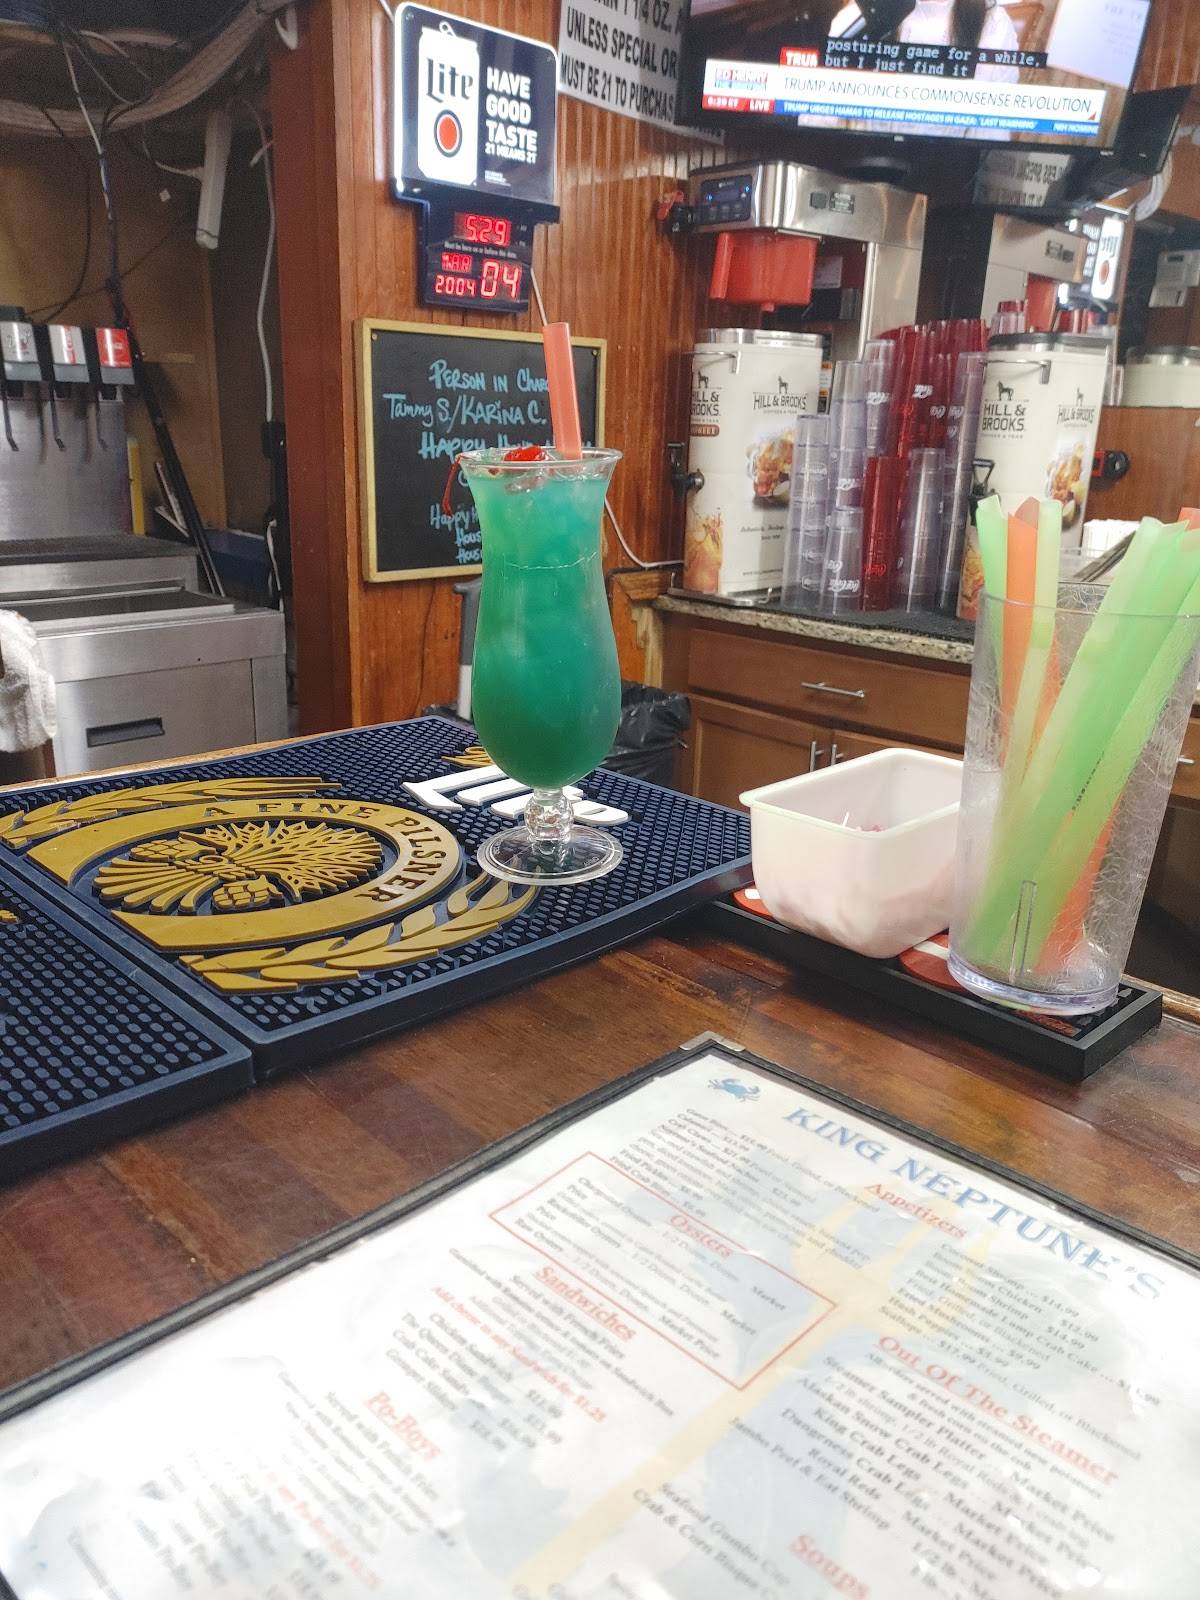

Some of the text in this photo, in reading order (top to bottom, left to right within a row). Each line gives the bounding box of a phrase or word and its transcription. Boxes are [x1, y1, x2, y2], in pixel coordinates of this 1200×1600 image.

[566, 6, 608, 53] UNLESS
[611, 28, 657, 73] SPECIAL
[827, 39, 1040, 67] posturing game for a while.
[426, 57, 473, 103] Lite
[560, 53, 585, 91] MUST
[587, 65, 599, 97] BE
[601, 71, 612, 102] 21
[615, 76, 627, 107] TO
[825, 55, 968, 76] but I just find it
[486, 66, 531, 100] HAVE
[784, 77, 826, 92] TRUMP
[828, 80, 908, 99] ANNOUNCES
[911, 87, 1011, 108] COMMONSENSE
[1014, 94, 1092, 113] REVOLUTION
[486, 93, 531, 125] GOOD
[749, 98, 770, 110] LIVE
[784, 102, 809, 112] TRUMP
[486, 119, 537, 152] TASTE
[485, 142, 495, 156] 21
[526, 152, 537, 164] 21
[435, 275, 476, 297] 2004
[481, 260, 520, 299] 04
[428, 359, 486, 391] PERSON
[493, 374, 508, 392] IN
[383, 393, 433, 427] Tammy
[527, 400, 547, 424] C.
[711, 391, 719, 402] &
[753, 393, 806, 410] HILL & BROOKS
[984, 404, 1026, 416] HILL &
[982, 418, 1024, 431] BROOKS
[430, 503, 470, 531] Happy
[456, 547, 482, 563] Hous
[203, 802, 447, 902] A FINE PILSNER
[784, 1107, 888, 1163] KING
[893, 1157, 1166, 1300] NEPTUNE'S
[864, 1183, 968, 1240] Appetizers
[668, 1215, 733, 1256] Oysters
[537, 1268, 637, 1337] Sandwiches
[989, 1296, 1028, 1320] Shrimp
[998, 1287, 1041, 1312] Chicken
[365, 1392, 445, 1458] Po-Boys
[798, 1377, 851, 1413] Alaskan
[853, 1411, 892, 1439] Snow
[894, 1437, 931, 1463] Crab
[878, 1336, 1117, 1484] Out Of The Steamer
[878, 1390, 933, 1428] Sampler
[938, 1427, 986, 1459] Platter
[814, 1408, 848, 1433] King
[849, 1430, 885, 1457] Crab
[885, 1455, 922, 1481] Legs
[945, 1493, 1002, 1534] Market
[856, 1457, 892, 1484] Crab
[791, 1534, 875, 1600] Soups
